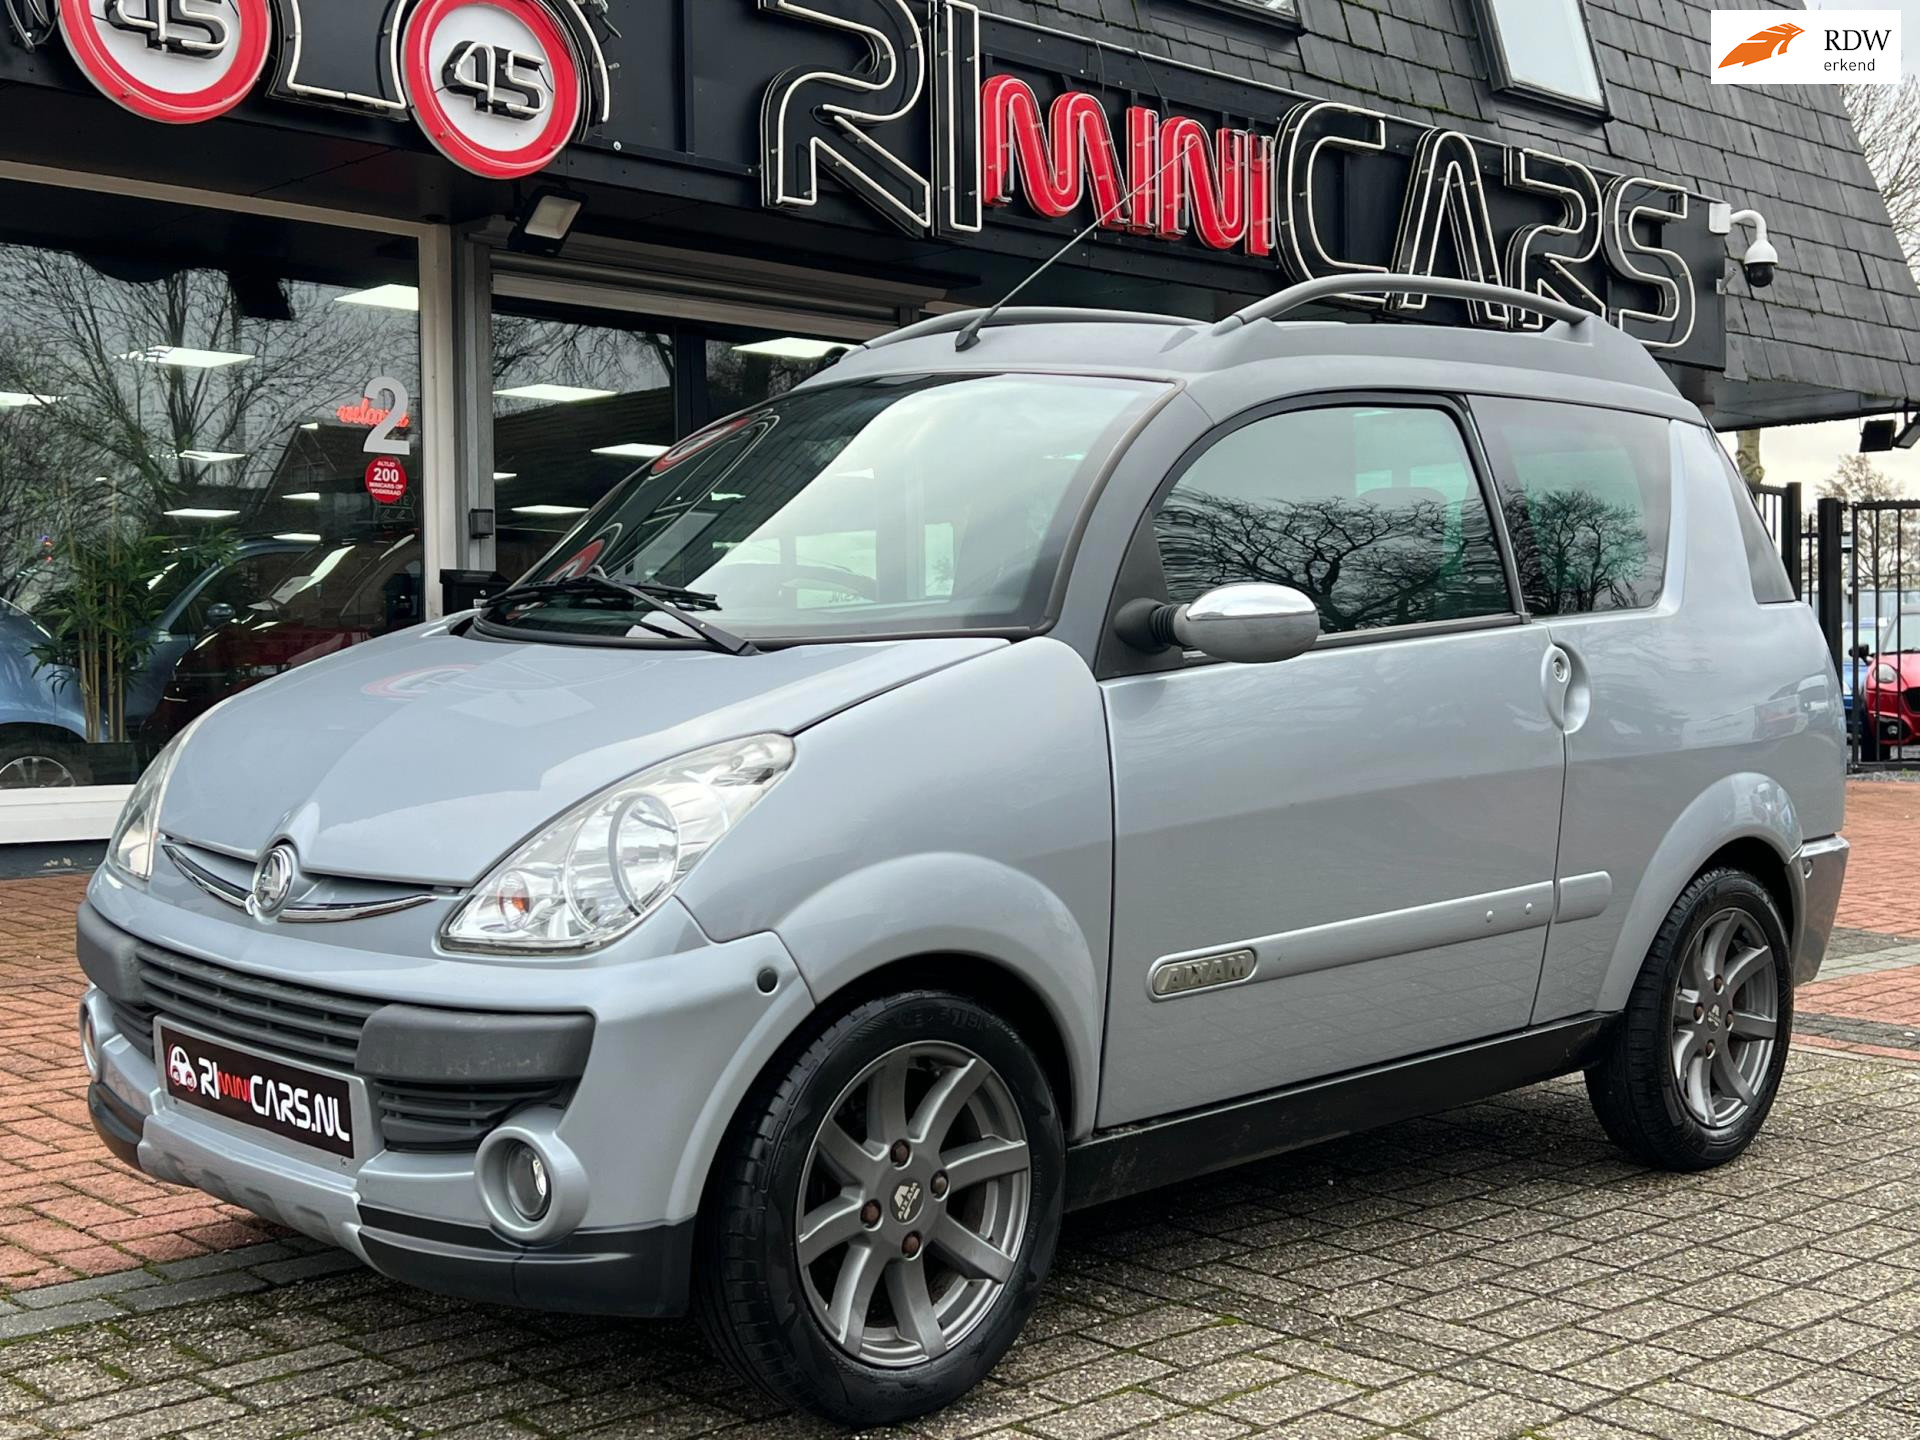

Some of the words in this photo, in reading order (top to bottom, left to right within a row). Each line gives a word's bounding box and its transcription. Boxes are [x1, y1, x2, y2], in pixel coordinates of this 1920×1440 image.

[442, 40, 547, 121] 45
[363, 376, 411, 455] 2
[373, 467, 399, 482] 200
